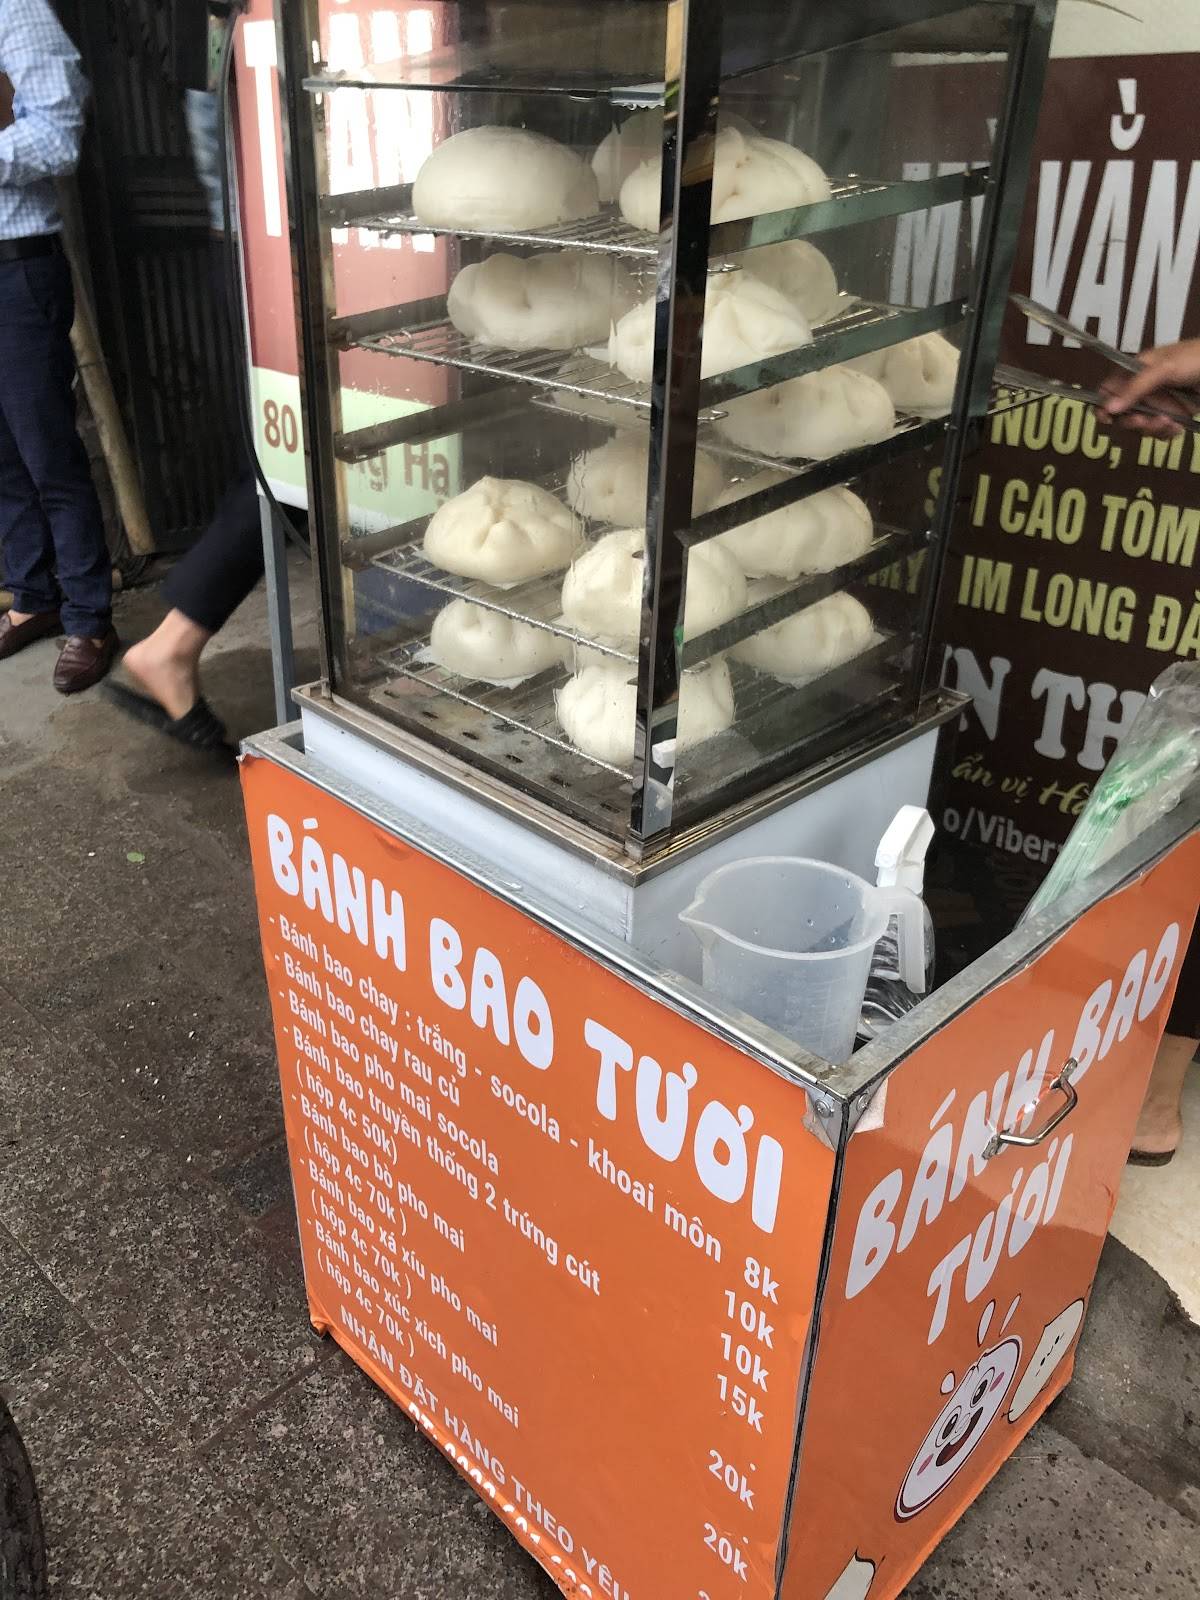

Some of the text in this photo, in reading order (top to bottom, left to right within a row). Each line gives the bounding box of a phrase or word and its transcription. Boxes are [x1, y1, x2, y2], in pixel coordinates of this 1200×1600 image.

[263, 398, 299, 454] 80
[1000, 464, 1087, 545] CẢO
[1101, 486, 1200, 568] TÔM
[958, 554, 1014, 615] IM
[1020, 567, 1138, 644] LONG
[266, 813, 784, 1234] BÁNH BAO TƯƠI
[279, 913, 319, 963] Bánh
[322, 943, 354, 988] bao
[358, 976, 399, 1026] chay
[490, 1074, 560, 1144] socola
[588, 1137, 655, 1213] khoai
[664, 1202, 722, 1263] môn
[743, 1256, 780, 1305] 8k
[305, 1065, 334, 1110] hộp
[338, 1096, 358, 1127] 4c
[361, 1113, 398, 1166] 50k)
[846, 921, 1180, 1300] BÁNH BAO
[283, 951, 323, 1001] Bánh
[325, 981, 356, 1025] bao
[359, 1014, 399, 1064] chay
[403, 1047, 433, 1086] rau
[724, 1289, 775, 1350] 10k
[288, 988, 327, 1038] Bánh
[330, 1019, 360, 1063] bao
[364, 1053, 395, 1091] pho
[399, 1081, 432, 1122] mai
[437, 1112, 499, 1176] socola
[720, 1332, 769, 1393] 10k
[292, 1024, 331, 1074] Bánh
[334, 1057, 364, 1100] bao
[426, 1135, 479, 1200] thống
[484, 1181, 497, 1211] 2
[502, 1198, 558, 1266] trứng
[565, 1254, 601, 1296] cút
[717, 1373, 764, 1434] 15k
[312, 1132, 341, 1176] hộp
[344, 1163, 363, 1193] 4c
[366, 1180, 396, 1224] 70k
[319, 1195, 347, 1238] hộp
[350, 1227, 368, 1256] 4c
[371, 1245, 401, 1287] 70k
[926, 1132, 1074, 1346] TƯƠI
[300, 1093, 338, 1142] Bánh
[340, 1126, 370, 1169] bao
[372, 1154, 394, 1189] bò
[397, 1180, 429, 1220] pho
[433, 1212, 465, 1253] mai
[708, 1449, 755, 1511] 20k
[308, 1158, 345, 1207] Bánh
[347, 1191, 375, 1234] bao
[379, 1226, 397, 1255] xá
[430, 1272, 462, 1312] pho
[466, 1305, 498, 1347] mai
[703, 1522, 748, 1582] 20k
[315, 1219, 350, 1267] Bánh
[352, 1253, 380, 1294] bao
[451, 1352, 483, 1392] pho
[487, 1386, 519, 1428] mai
[325, 1255, 352, 1296] hộp
[355, 1287, 373, 1314] 4c
[375, 1303, 405, 1346] 70k
[340, 1304, 394, 1373] NHẬN
[398, 1363, 439, 1413] ĐẶT
[444, 1407, 506, 1485] HÀNG
[511, 1475, 574, 1553] THEO
